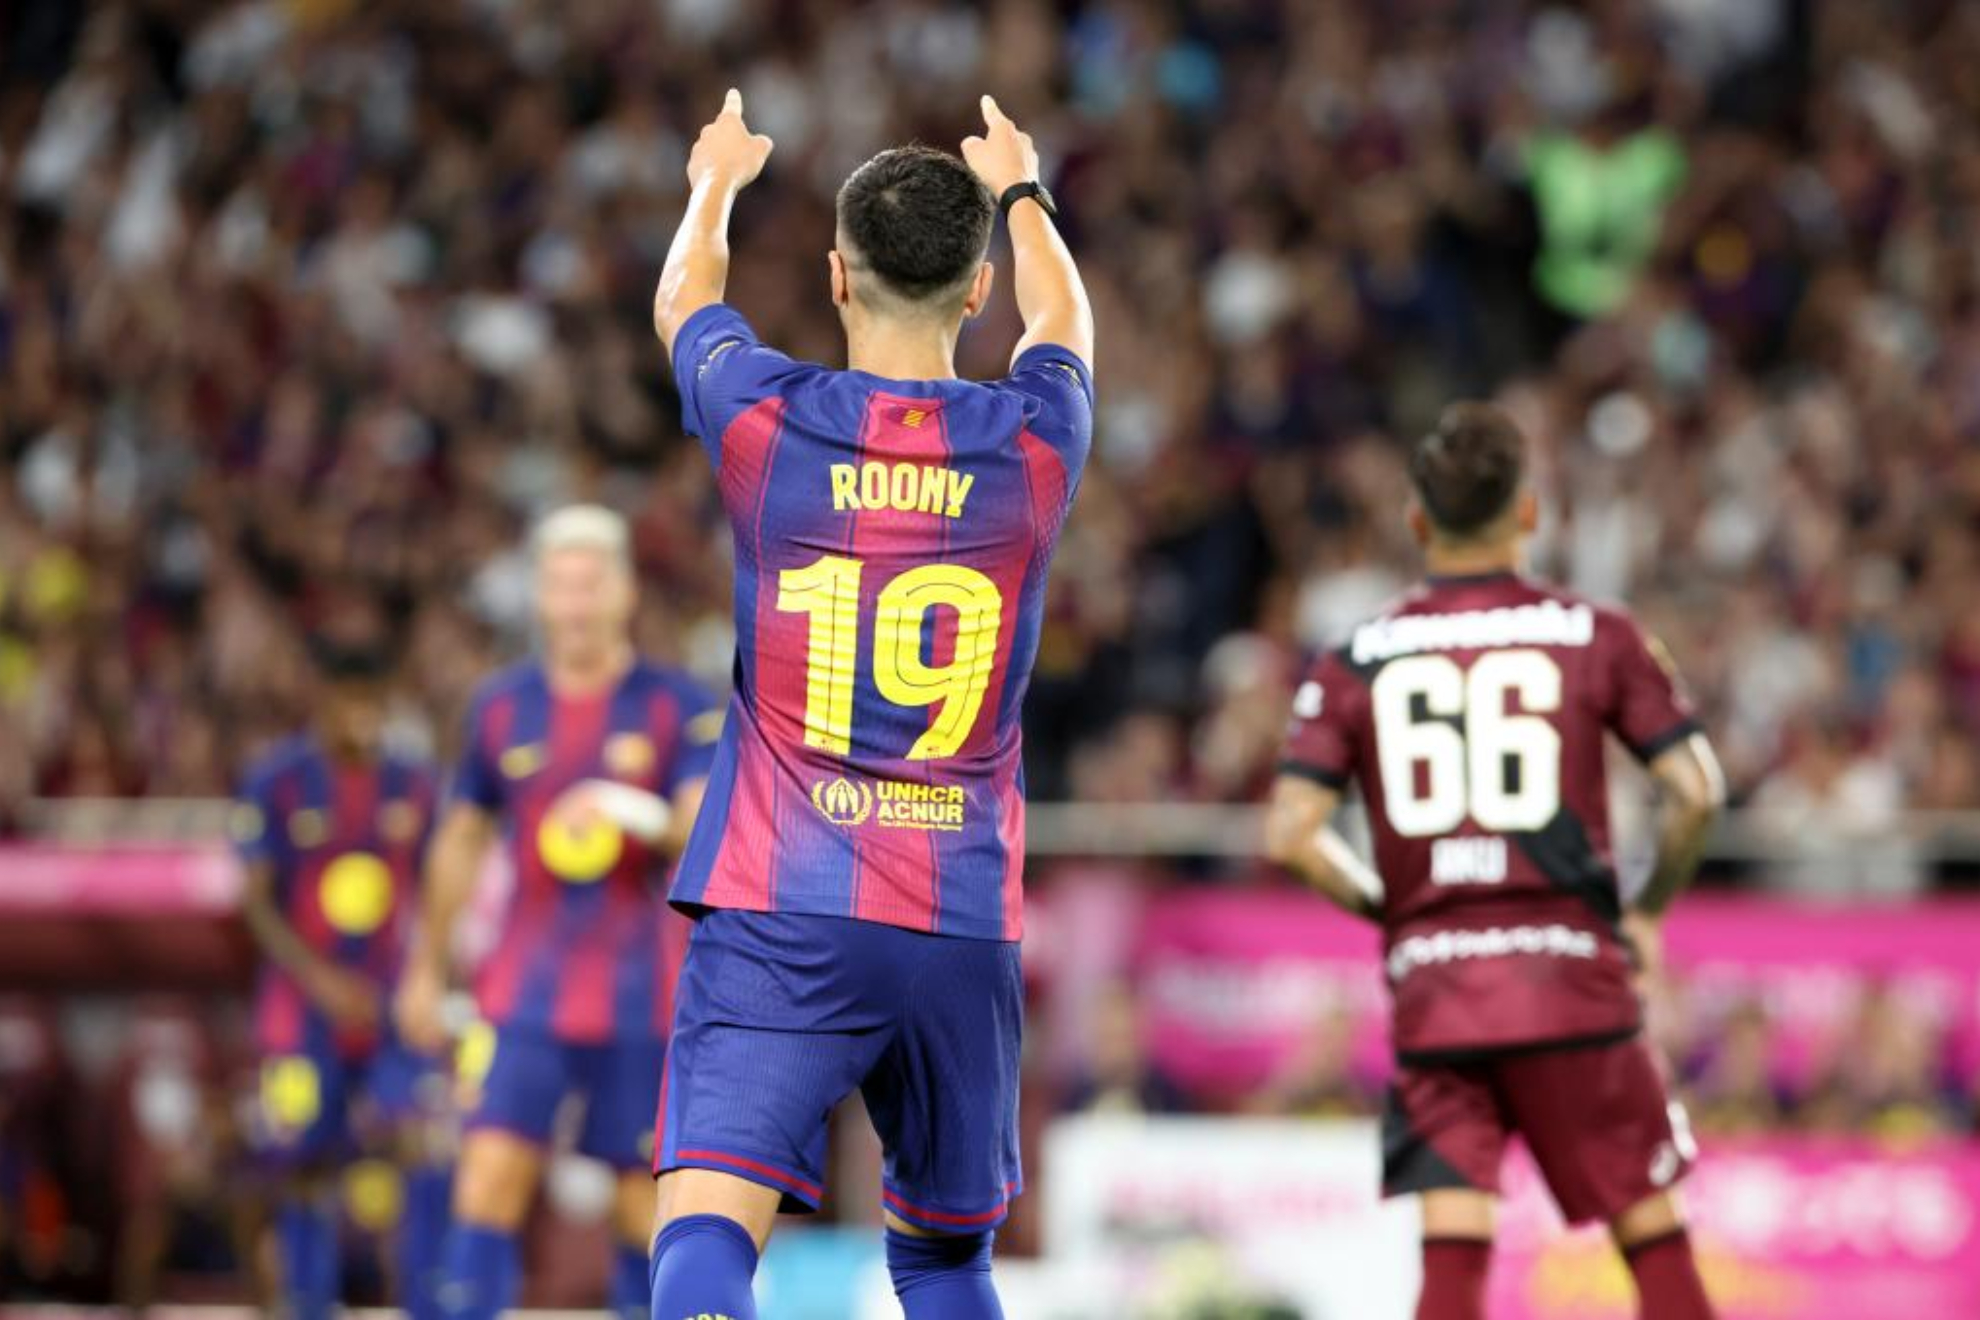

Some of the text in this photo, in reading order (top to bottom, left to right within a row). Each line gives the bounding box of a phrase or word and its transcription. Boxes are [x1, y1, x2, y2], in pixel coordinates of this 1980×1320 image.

[830, 461, 975, 518] ROONY
[776, 555, 1003, 761] 19
[1372, 649, 1562, 837] 66
[876, 780, 964, 803] UNHCR
[876, 801, 964, 823] ACNUR
